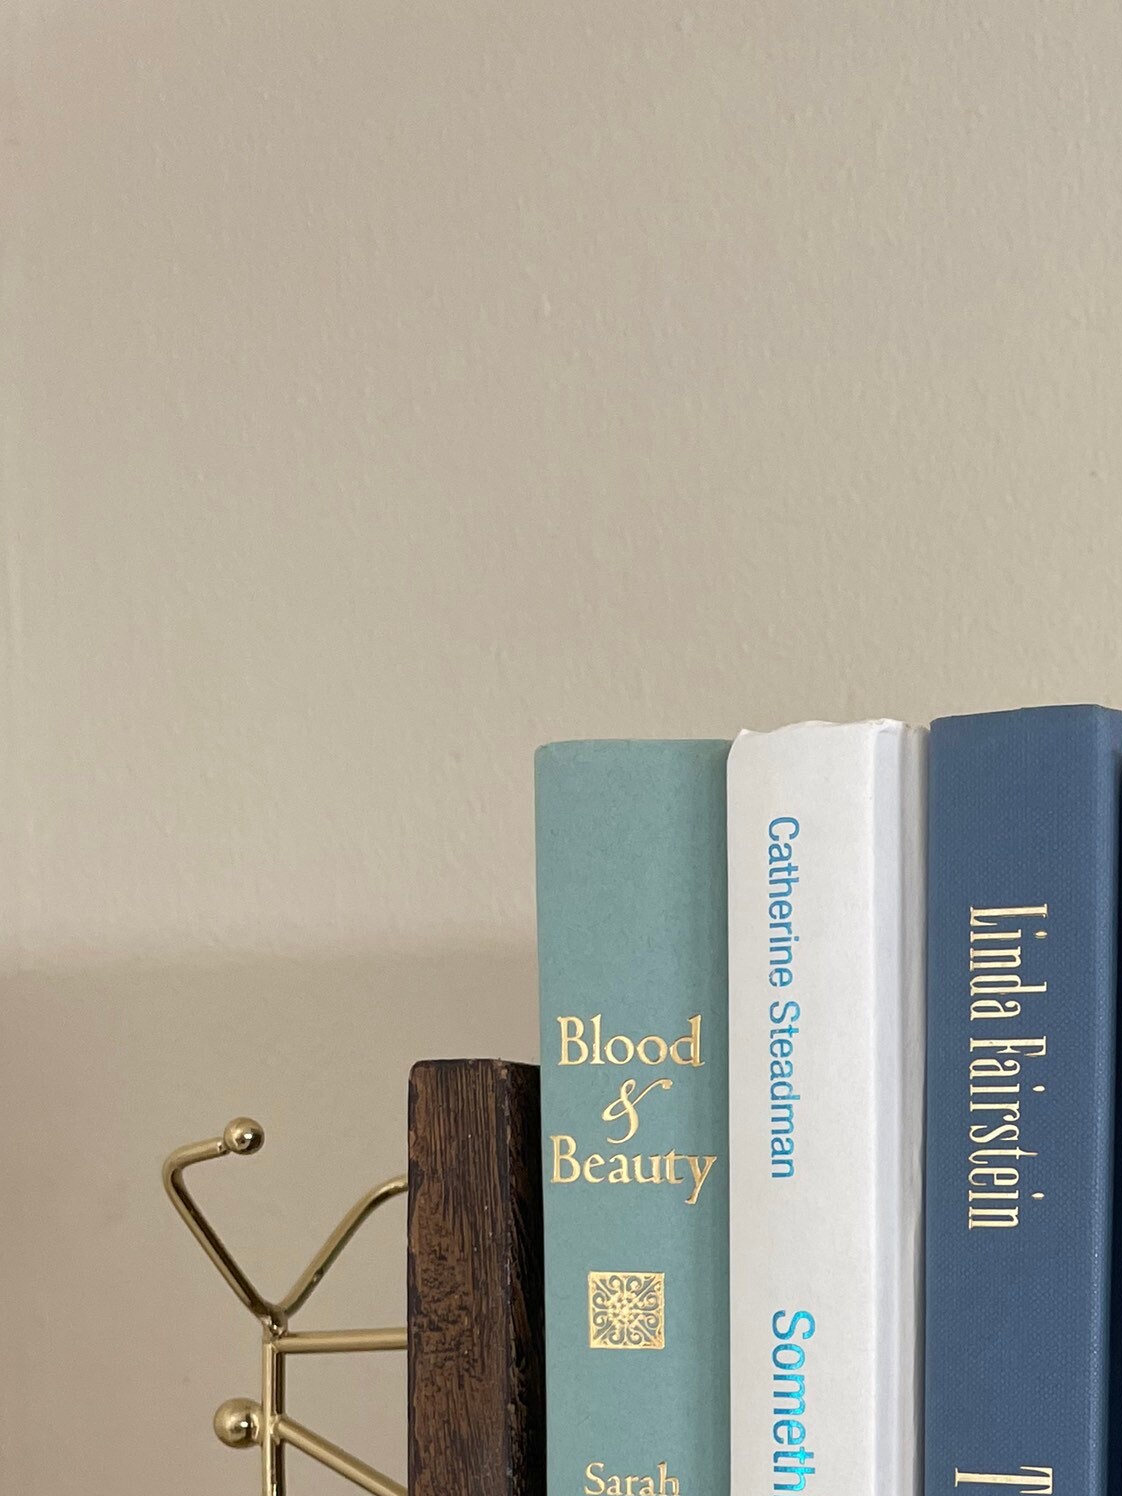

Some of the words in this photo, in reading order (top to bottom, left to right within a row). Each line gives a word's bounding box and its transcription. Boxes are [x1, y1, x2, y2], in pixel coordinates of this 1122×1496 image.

[768, 816, 800, 988] Catherine
[969, 903, 1048, 1022] Linda
[557, 1014, 705, 1067] Blood
[769, 1000, 801, 1179] Steadman
[550, 1134, 717, 1205] Beauty
[602, 1078, 673, 1144] &
[968, 1036, 1046, 1230] Fairstein
